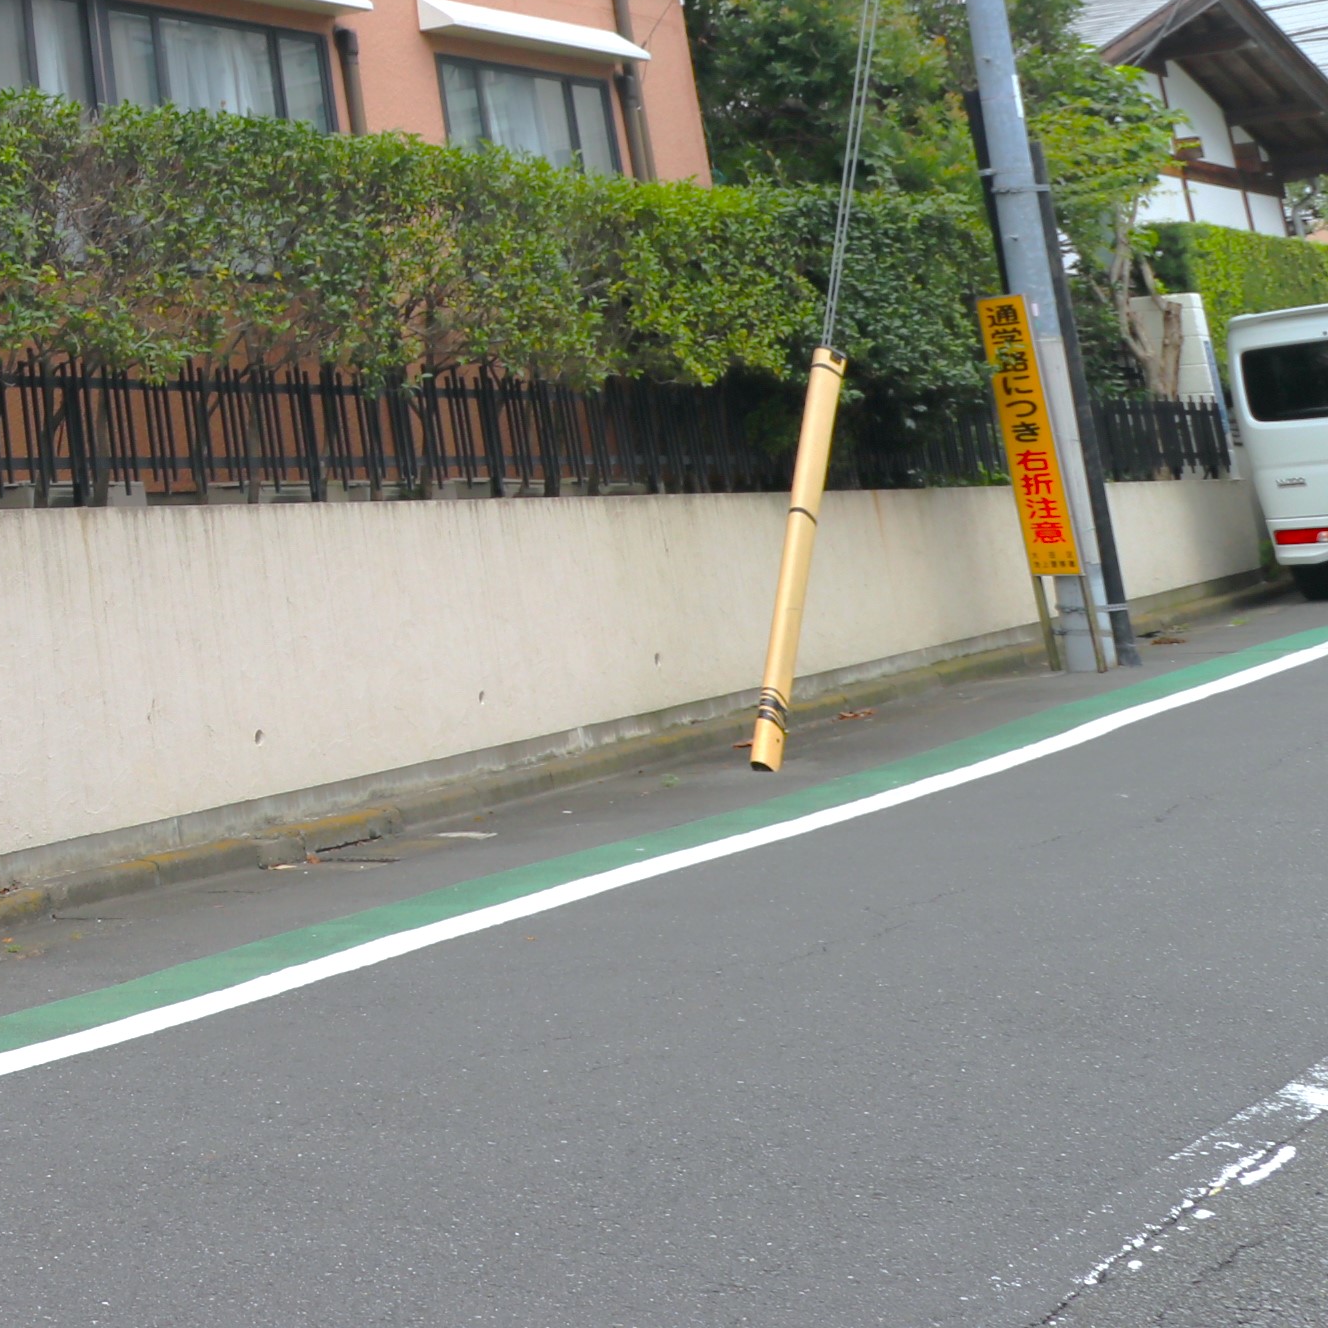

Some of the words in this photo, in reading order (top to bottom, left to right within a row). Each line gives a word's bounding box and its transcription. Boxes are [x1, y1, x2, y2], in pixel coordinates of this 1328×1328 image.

[986, 304, 1040, 443] 通学路につき
[1016, 450, 1066, 543] 右折注意
